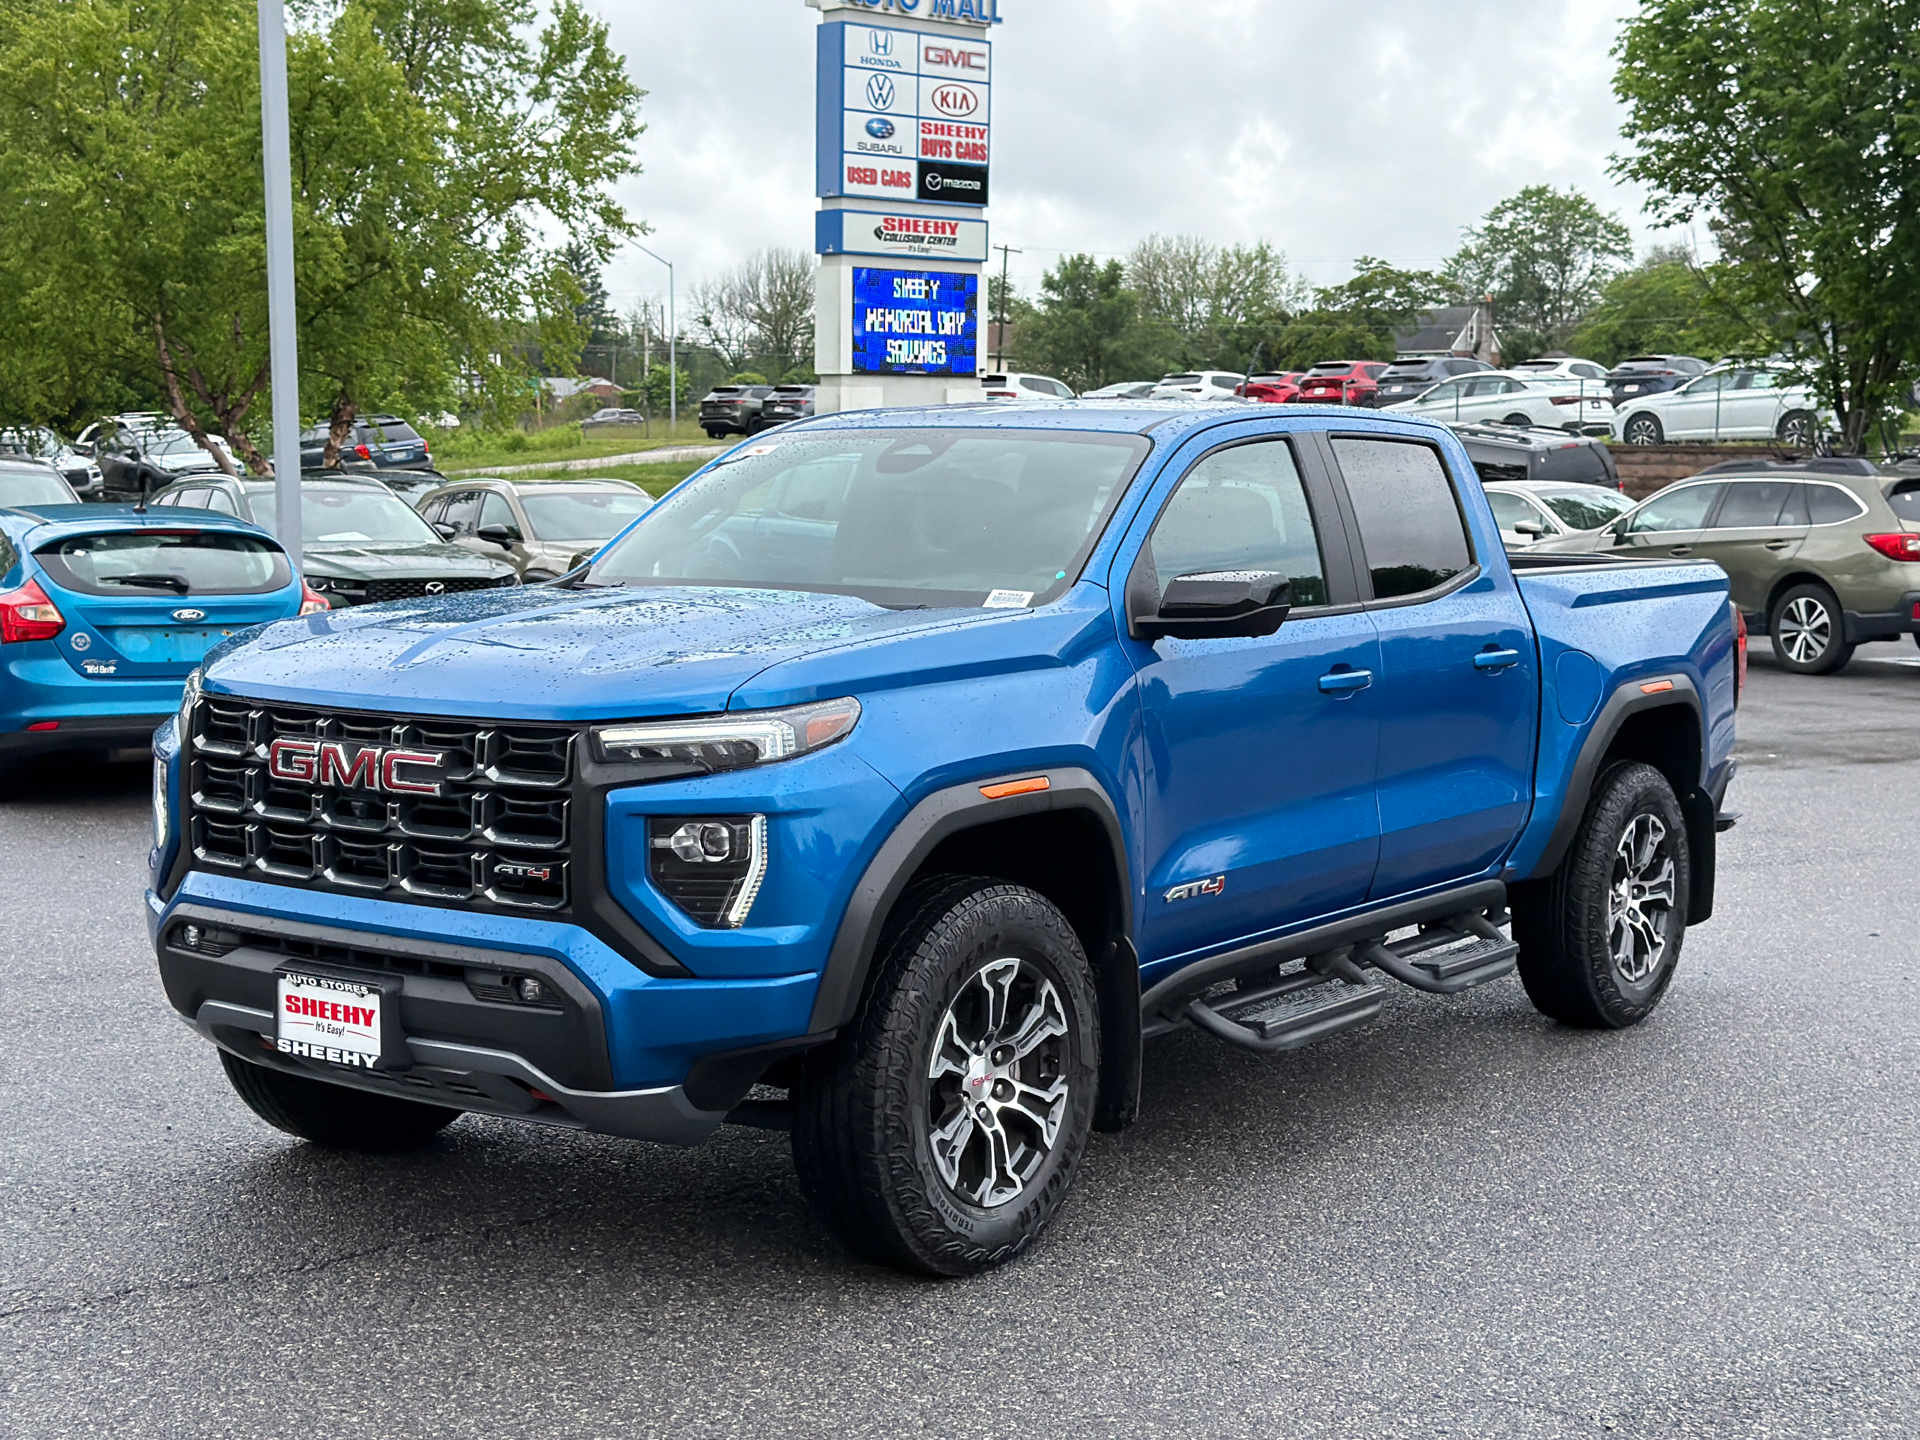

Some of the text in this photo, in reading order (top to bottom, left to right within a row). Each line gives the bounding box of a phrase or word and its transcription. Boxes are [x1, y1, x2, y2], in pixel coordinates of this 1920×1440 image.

[932, 0, 1003, 23] MALL
[859, 56, 902, 68] HONDA
[925, 46, 986, 71] GMC
[940, 90, 970, 111] KIA
[921, 122, 987, 140] SHEEHY
[857, 141, 902, 154] SUBARU
[921, 138, 987, 161] BUYS CARS
[847, 166, 911, 189] USED CARS
[943, 178, 981, 190] mazda
[883, 217, 959, 236] SHEEHY
[883, 232, 957, 246] COLLISION CENTER
[937, 310, 966, 335] DAY
[84, 665, 98, 674] Ted
[269, 738, 443, 797] GMC
[494, 864, 550, 881] AT4
[1163, 875, 1225, 903] AT4
[285, 973, 369, 995] AUTO STORES
[285, 994, 376, 1027] SHEEHY
[315, 1021, 346, 1038] It's Easy!
[277, 1038, 379, 1069] SHEEHY
[972, 1072, 993, 1087] GMC
